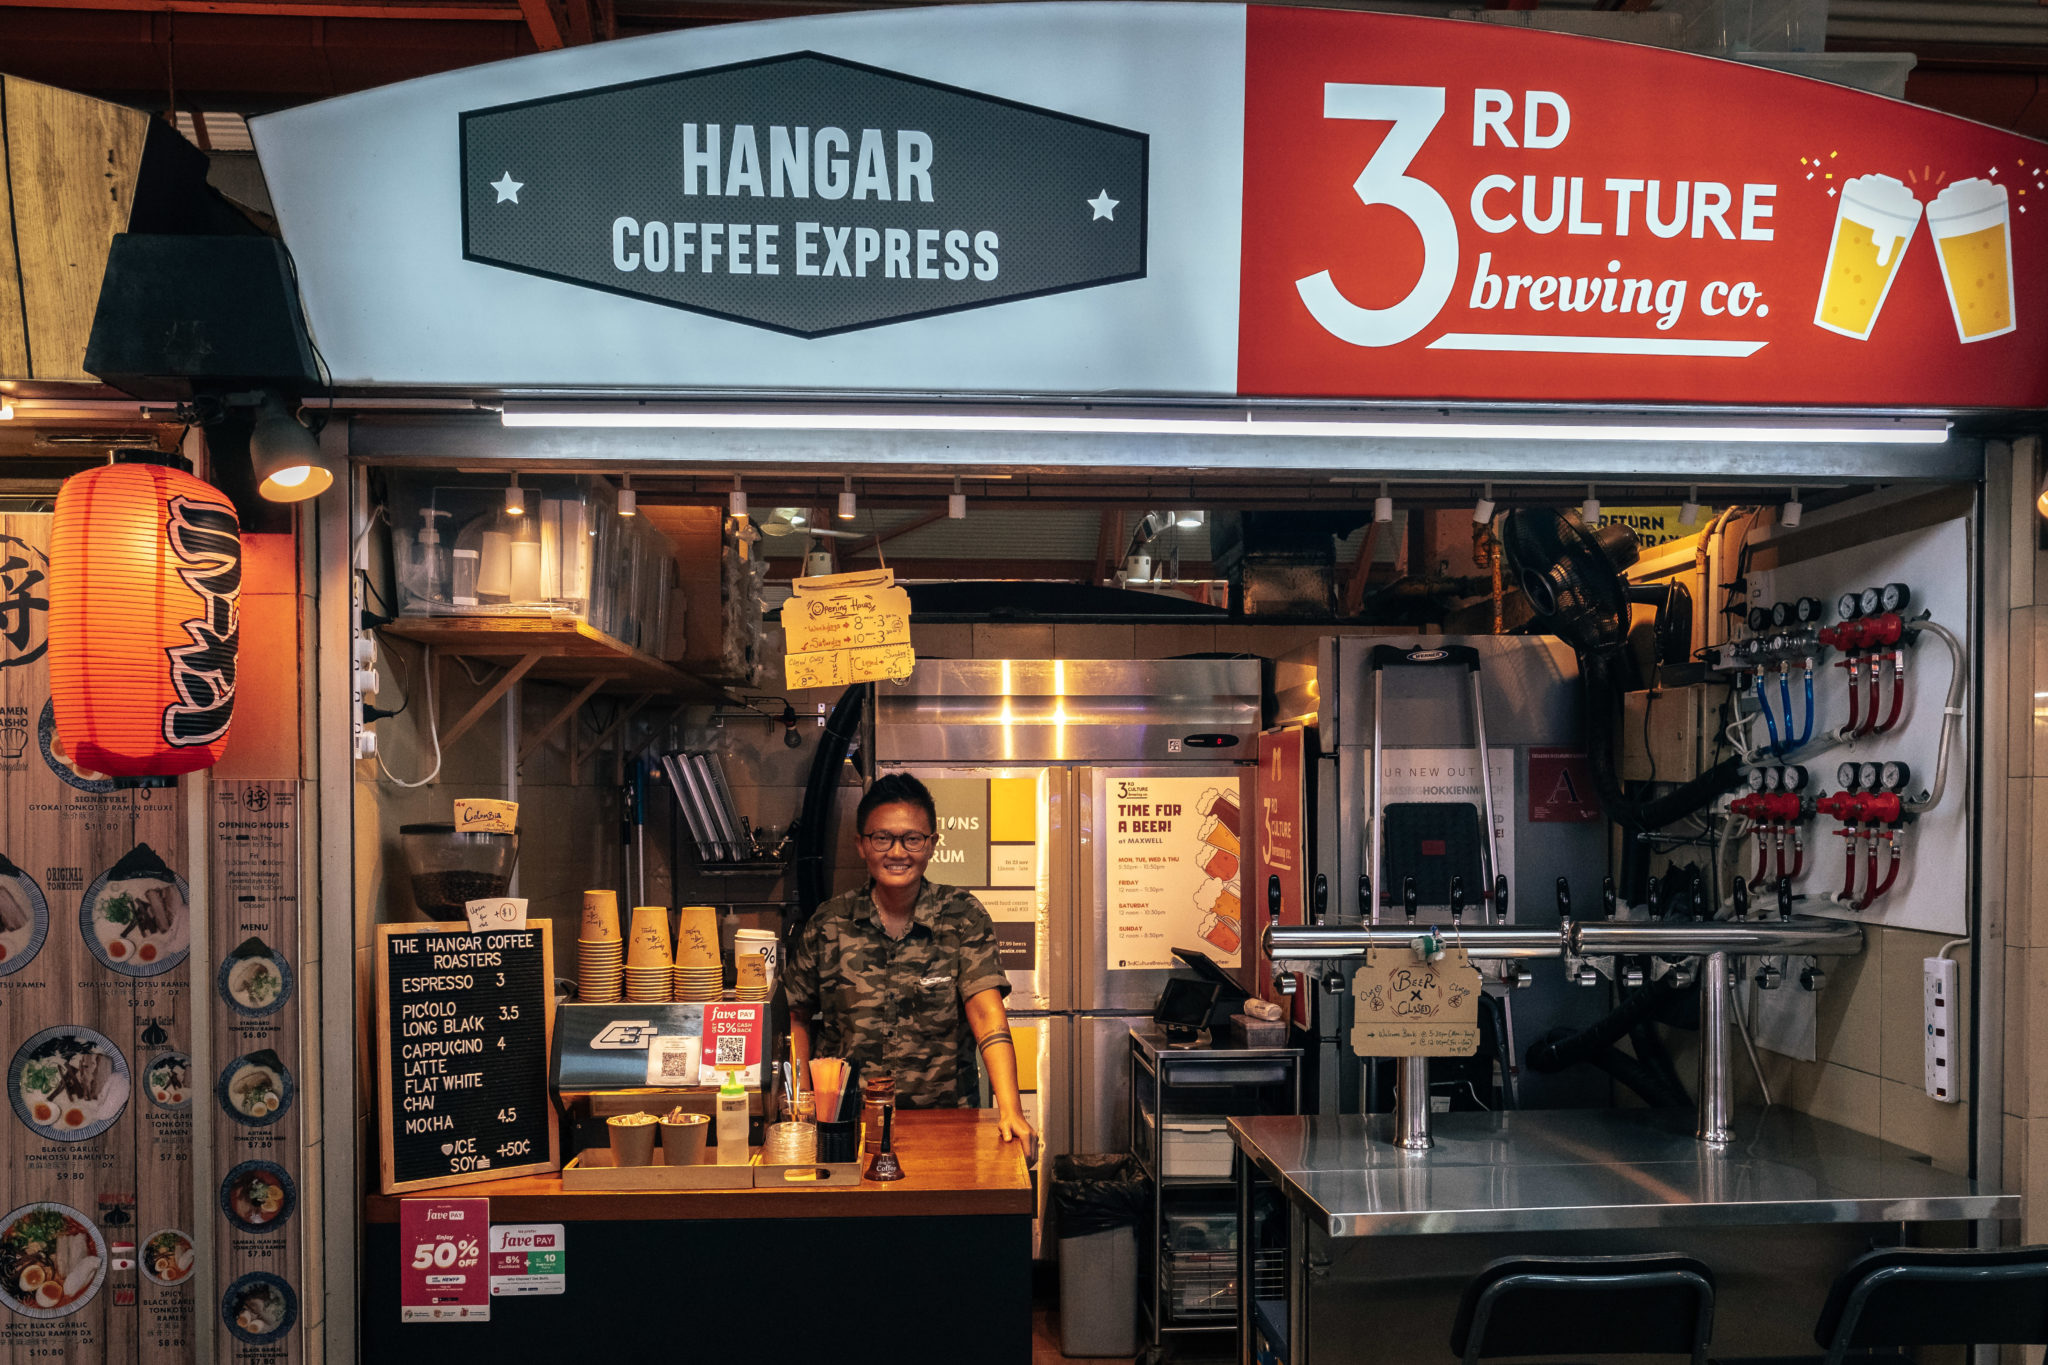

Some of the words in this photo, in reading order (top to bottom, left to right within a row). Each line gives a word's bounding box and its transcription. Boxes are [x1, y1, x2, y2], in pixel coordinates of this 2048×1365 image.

[682, 122, 934, 202] HANGAR
[1295, 82, 1459, 347] 3
[1472, 88, 1571, 149] RD
[1470, 174, 1777, 241] CULTURE
[612, 216, 779, 275] COFFEE
[795, 222, 1000, 281] EXPRESS
[1470, 252, 1687, 330] brewing
[1699, 280, 1770, 317] co.
[1598, 515, 1664, 531] RETURN
[812, 601, 847, 616] Opening
[850, 599, 872, 611] Hours
[0, 707, 28, 716] AMEN
[0, 718, 29, 727] AISHO
[1384, 768, 1402, 777] UR
[1409, 767, 1440, 777] NEW
[1447, 767, 1504, 777] OUTET
[1117, 782, 1128, 799] 3
[1118, 804, 1150, 816] TIME
[1155, 804, 1182, 816] FOR
[1118, 821, 1127, 832] A
[1132, 820, 1171, 832] BEER!
[1262, 798, 1271, 865] 3
[1271, 820, 1291, 839] CULTURE
[46, 867, 84, 881] ORIGINAL
[240, 923, 269, 931] MENU
[392, 939, 419, 954] THE
[426, 936, 482, 953] HANGAR
[487, 934, 534, 950] COFFEE
[433, 952, 502, 970] ROASTERS
[402, 974, 474, 993] ESPRESSO
[496, 973, 505, 987] 3
[402, 1001, 456, 1019] PICCOLO
[499, 1006, 519, 1021] 3.5
[710, 1007, 736, 1021] fave
[403, 1020, 438, 1037] LONG
[443, 1016, 485, 1034] BLACK
[717, 1022, 737, 1033] 5%
[497, 1037, 506, 1050] 4
[404, 1059, 447, 1077] LATTE
[405, 1077, 439, 1094] FLAT
[443, 1073, 483, 1091] WHITE
[405, 1115, 454, 1134] MOCHA
[497, 1108, 517, 1123] 4.5
[453, 1138, 477, 1155] ICE
[496, 1139, 531, 1157] +50¢
[160, 1153, 187, 1161] $7.80
[450, 1156, 478, 1173] SOY
[57, 1172, 85, 1180] $9.80
[876, 1164, 897, 1172] Coffee
[425, 1208, 448, 1221] fave
[500, 1231, 532, 1250] fave
[536, 1236, 553, 1245] PAY
[411, 1239, 479, 1270] 50%
[458, 1259, 478, 1267] OFF
[544, 1253, 556, 1262] 10
[29, 1348, 64, 1357] $10.80
